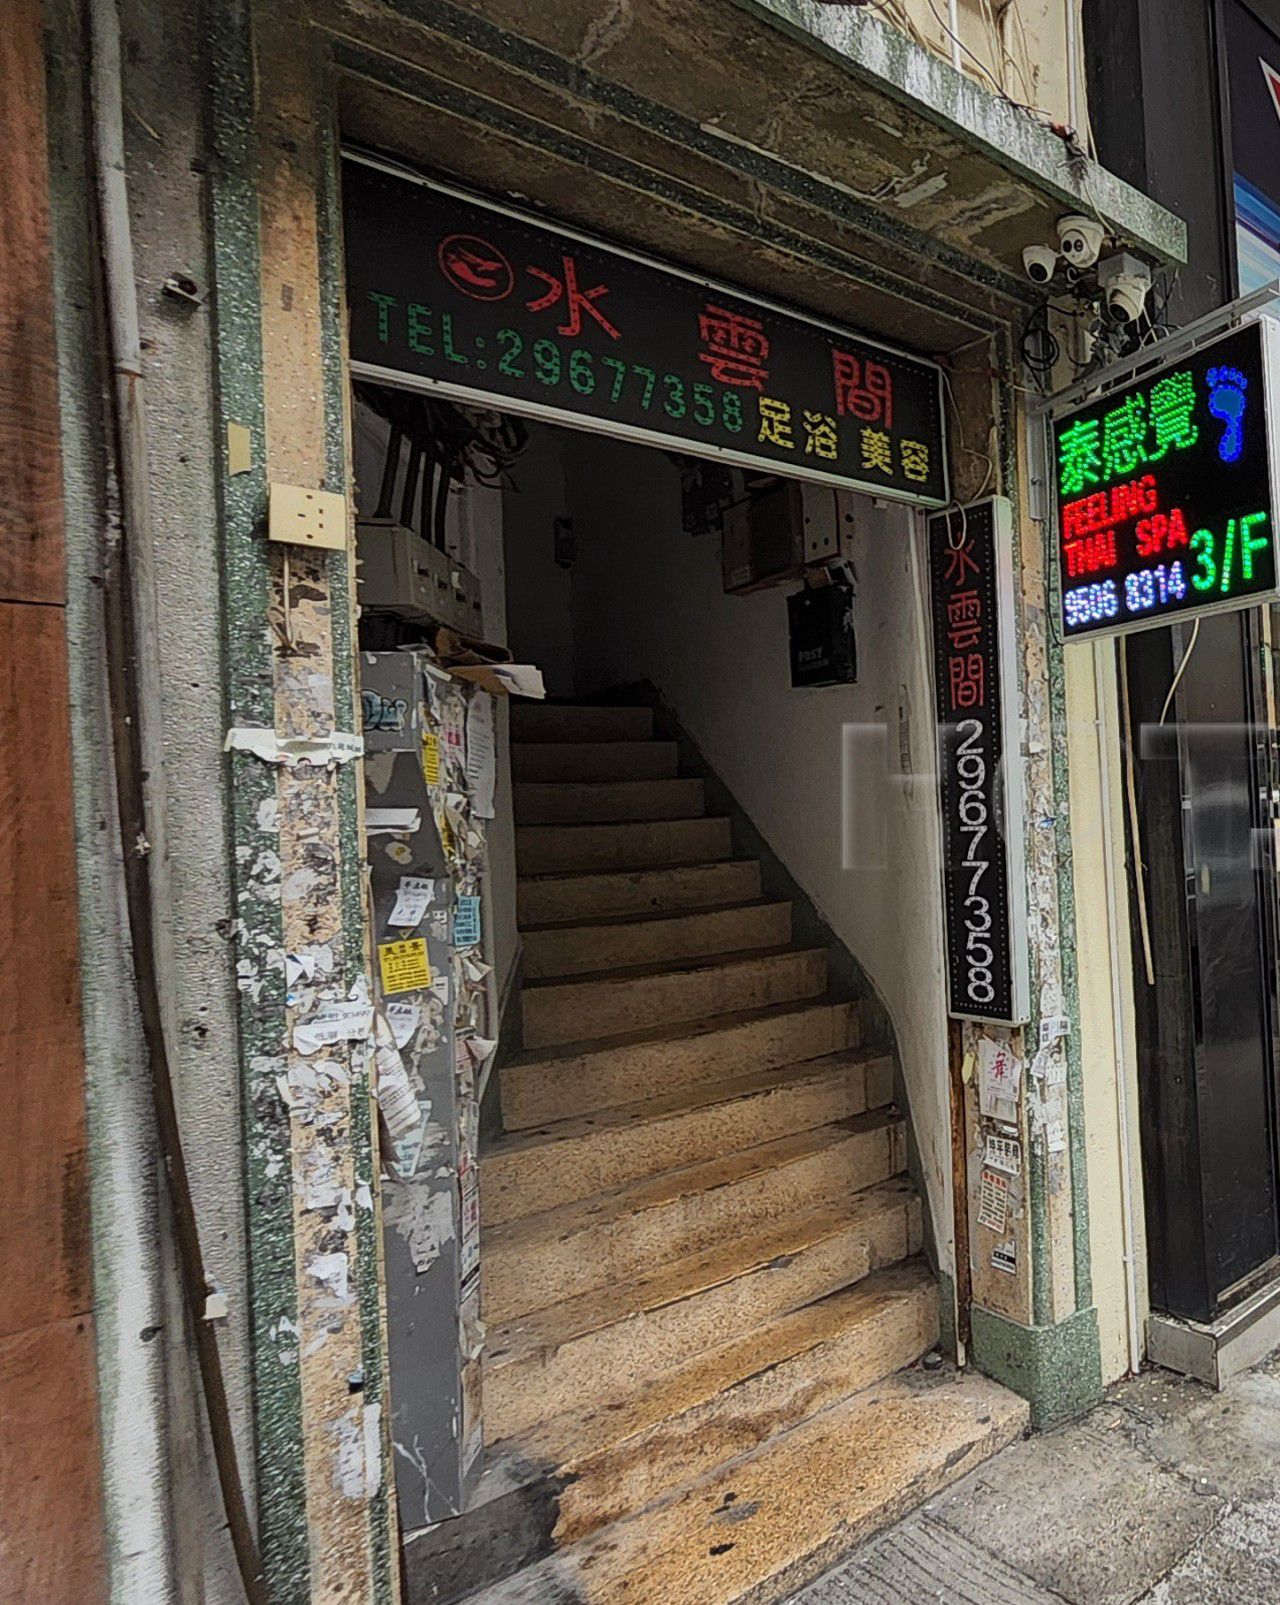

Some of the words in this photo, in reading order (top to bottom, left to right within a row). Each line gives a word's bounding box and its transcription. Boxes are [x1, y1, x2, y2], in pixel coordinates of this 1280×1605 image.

[367, 291, 745, 434] TEL:29677358
[526, 255, 894, 428] 水雲間
[1058, 369, 1199, 495] 泰感覺
[1062, 473, 1158, 540] FEELING
[1063, 529, 1117, 577] THAI
[1135, 508, 1188, 557] SPA
[1189, 511, 1269, 593] 3/F
[944, 532, 984, 711] 水雲間
[955, 718, 996, 1004] 29677358
